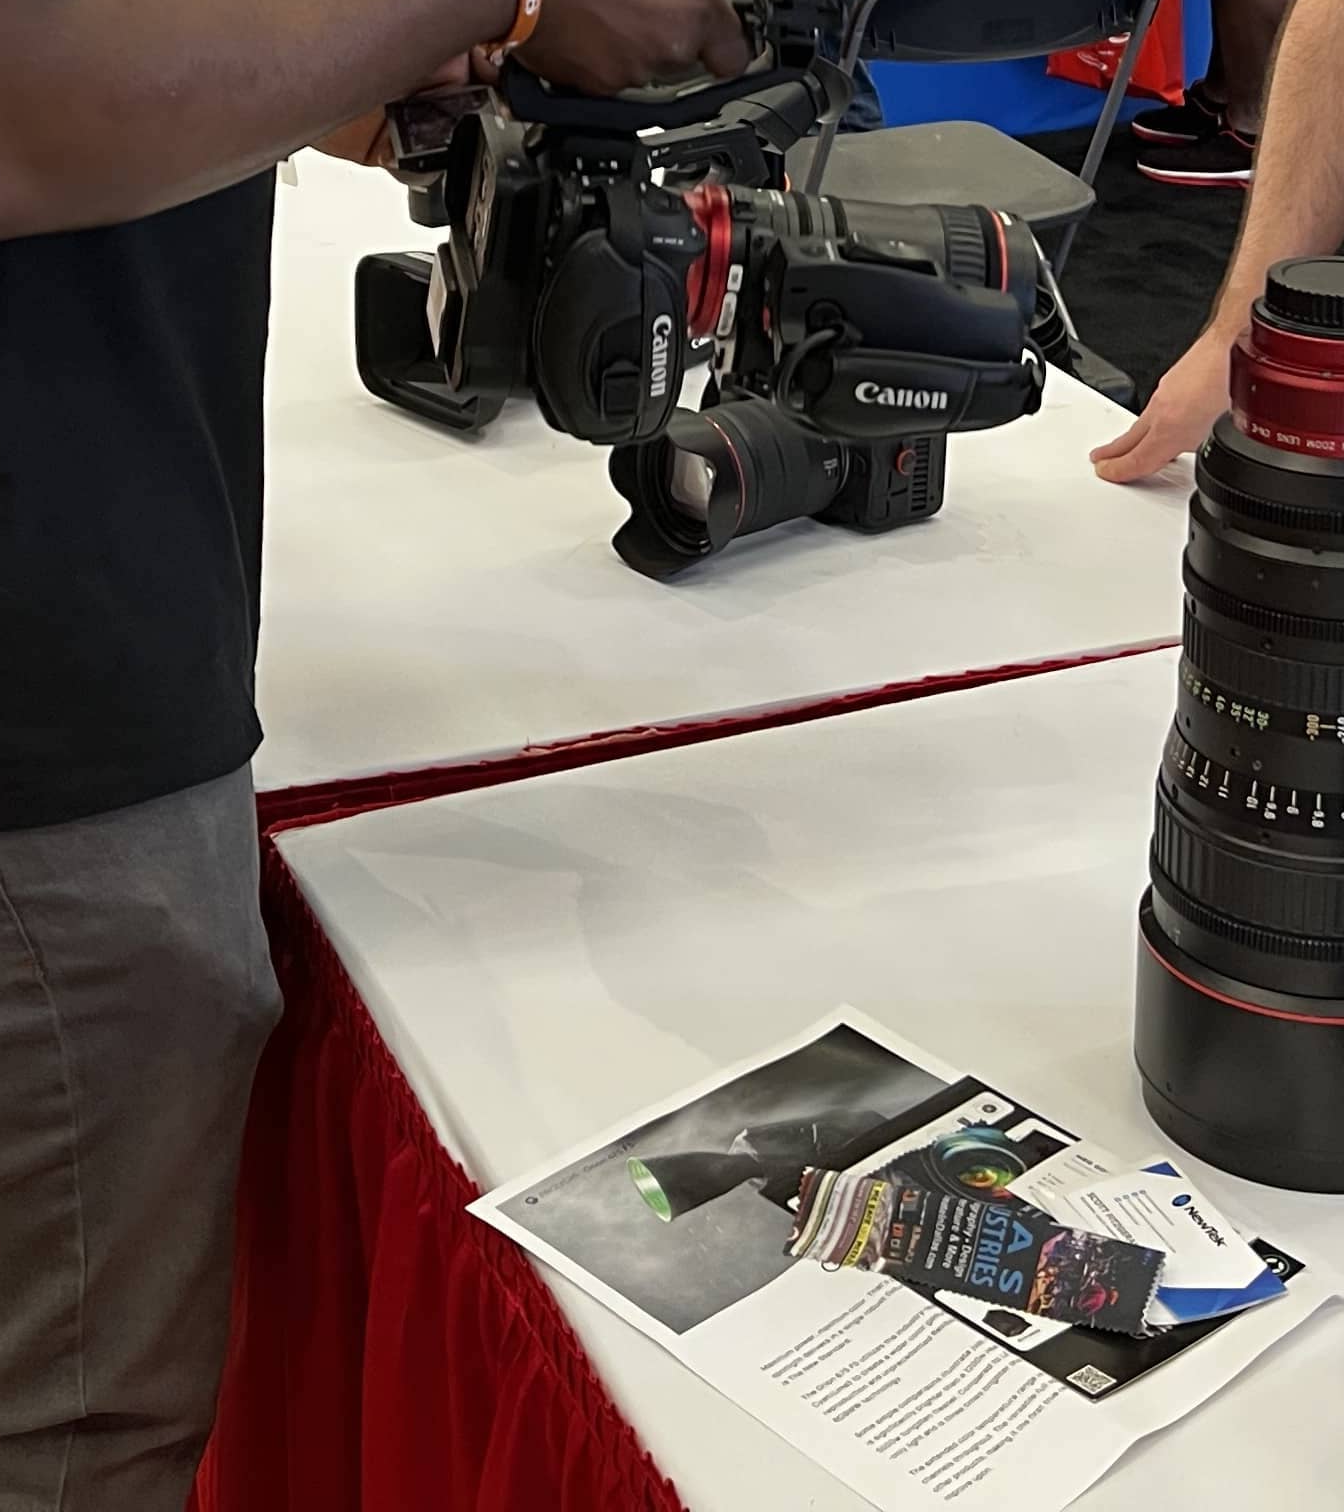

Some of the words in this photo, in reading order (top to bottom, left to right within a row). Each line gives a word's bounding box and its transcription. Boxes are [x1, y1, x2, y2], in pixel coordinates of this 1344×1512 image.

[650, 314, 673, 398] Canon
[854, 381, 948, 410] Canon
[1276, 432, 1301, 447] LENS
[1306, 439, 1336, 451] ZOOM
[1306, 714, 1320, 736] 300
[1246, 795, 1258, 809] 10
[1184, 1206, 1228, 1248] NewTek
[942, 1244, 958, 1269] More
[953, 1244, 973, 1278] Design
